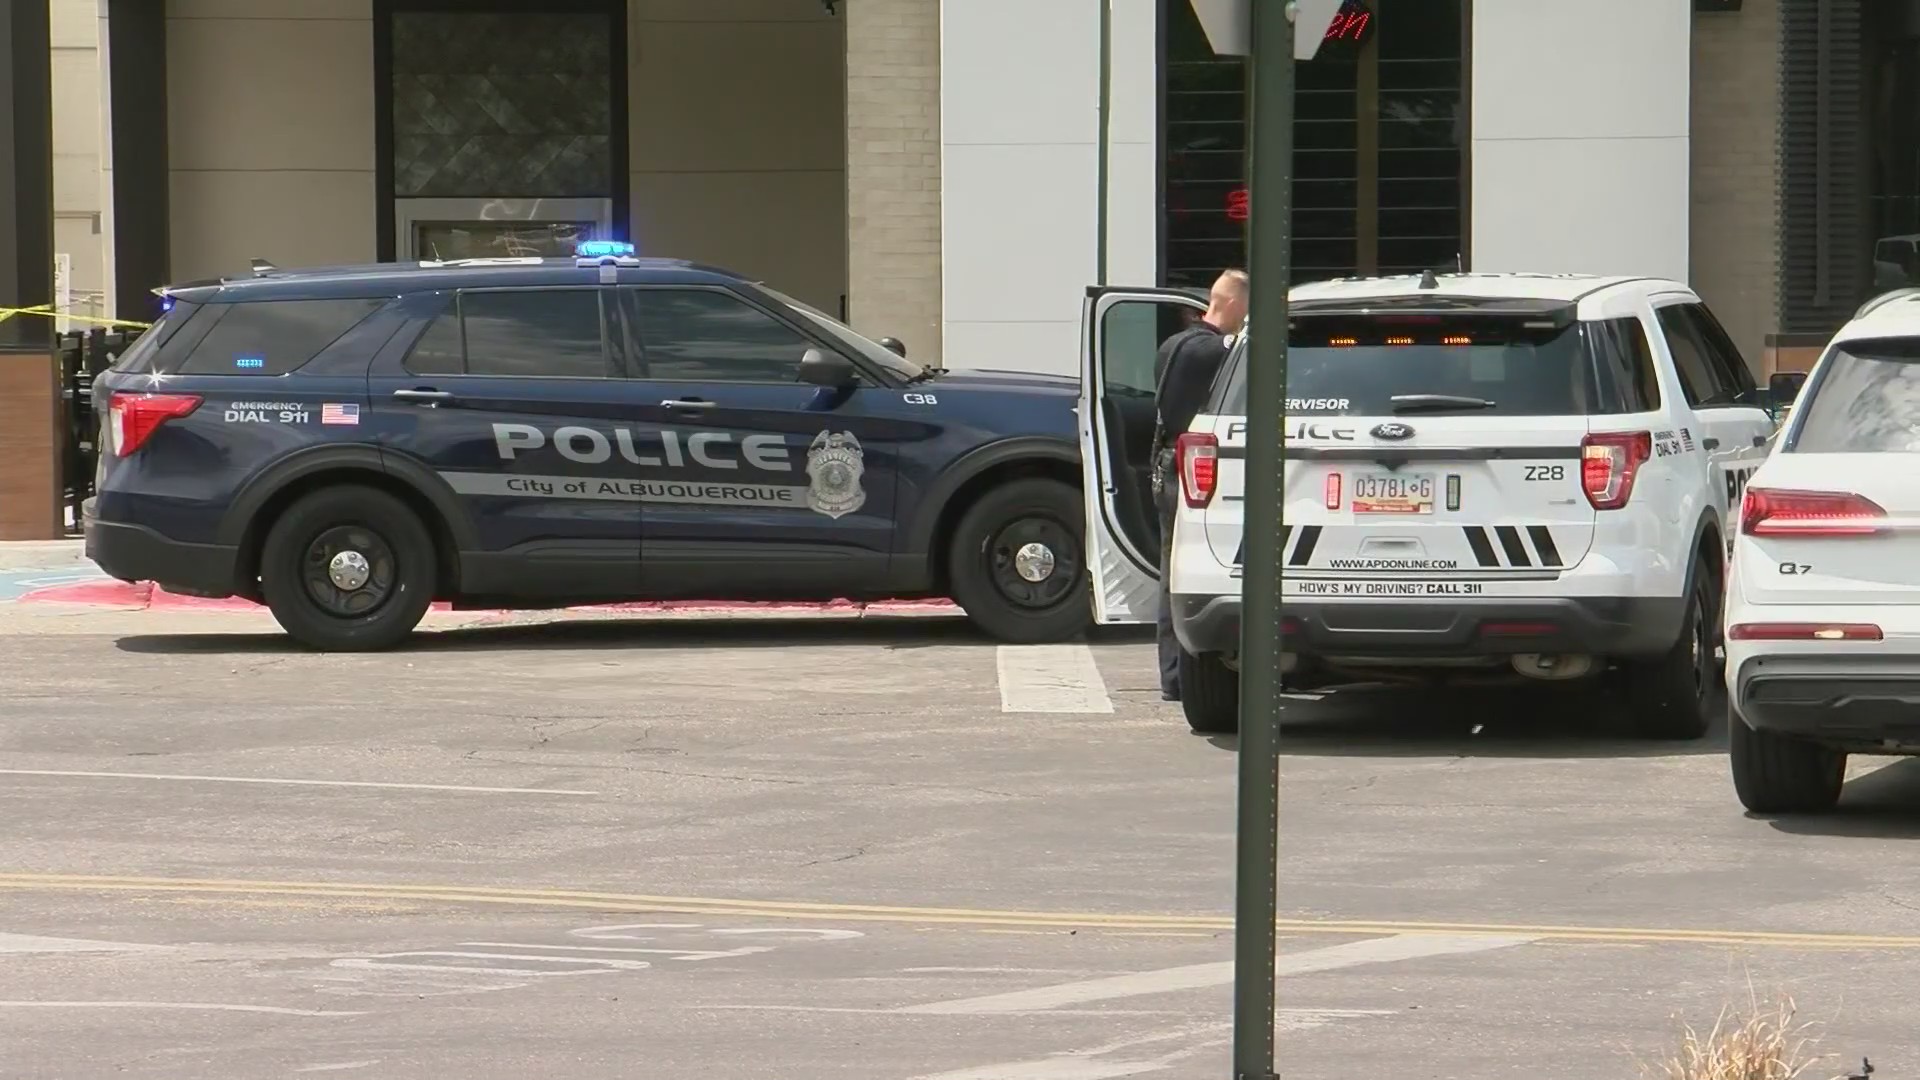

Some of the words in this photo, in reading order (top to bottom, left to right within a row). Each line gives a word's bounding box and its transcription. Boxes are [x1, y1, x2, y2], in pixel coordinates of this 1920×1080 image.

[1325, 11, 1370, 39] en
[903, 393, 938, 405] C38
[1285, 399, 1350, 410] ERVISOR
[231, 402, 304, 410] EMERGENCY
[224, 410, 270, 423] DIAL
[279, 411, 309, 423] 911
[492, 423, 792, 472] POLICE
[1524, 465, 1564, 481] Z28
[507, 478, 554, 495] City
[564, 480, 588, 495] of
[599, 482, 793, 502] ALBUQUERQUE
[1329, 559, 1458, 569] WWW.APDONLINE.COM
[1779, 562, 1812, 575] Q7
[1299, 582, 1340, 594] HOW'S
[1344, 583, 1363, 594] MY
[1366, 583, 1424, 595] DRIVING?
[1426, 583, 1461, 594] CALL
[1463, 584, 1483, 594] 311
